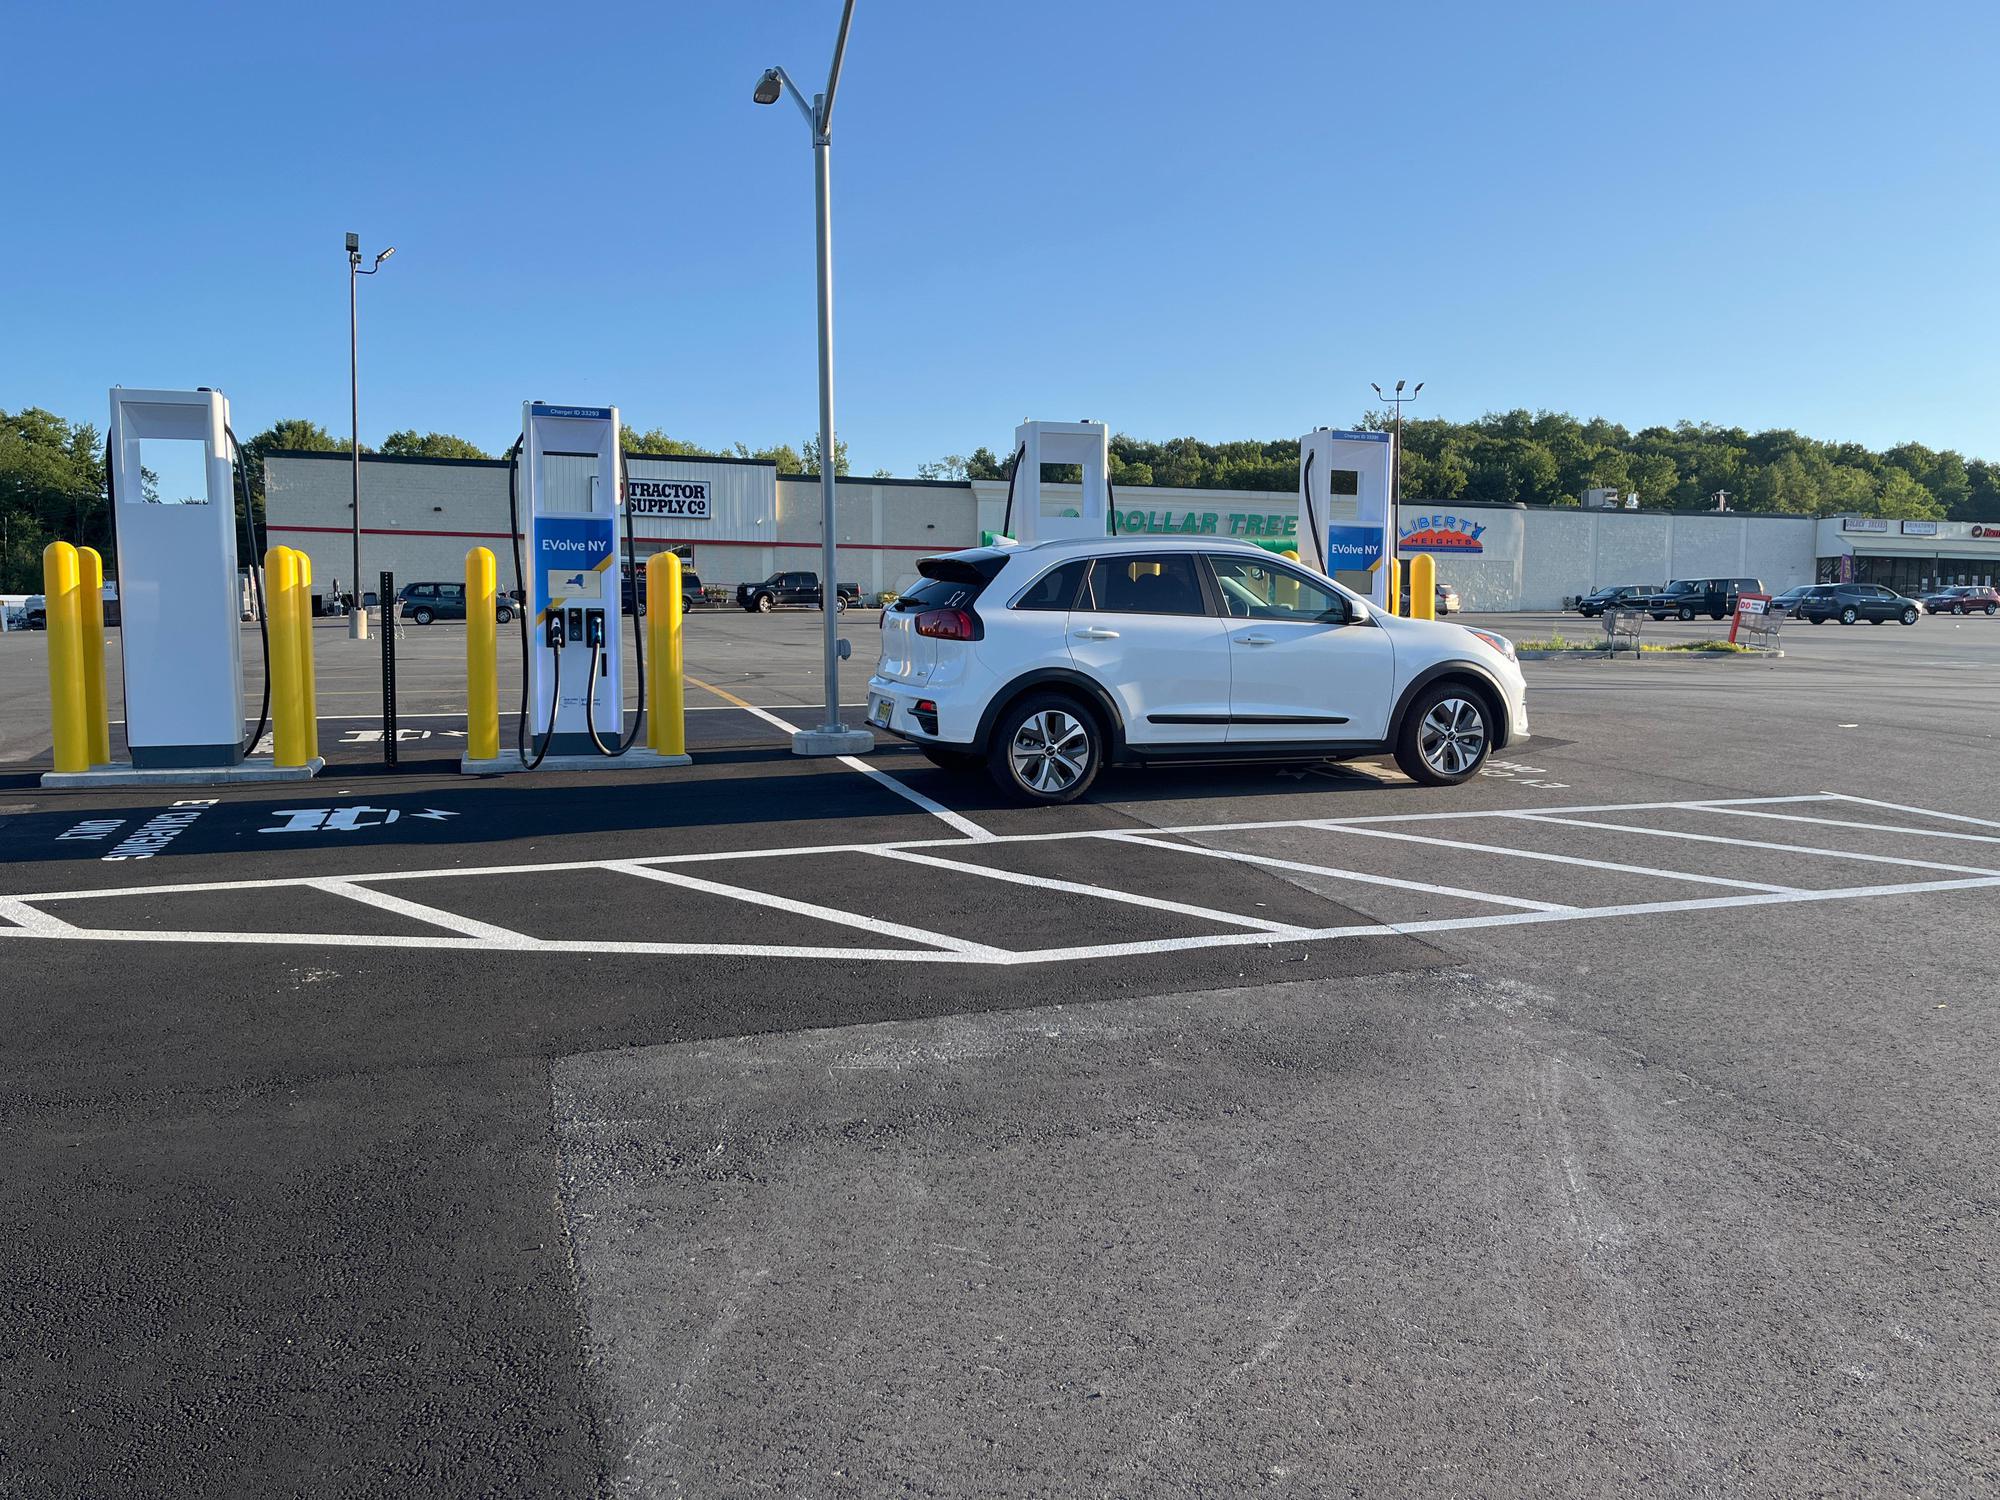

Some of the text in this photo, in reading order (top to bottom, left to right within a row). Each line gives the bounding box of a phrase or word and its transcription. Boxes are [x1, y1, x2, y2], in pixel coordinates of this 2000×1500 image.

[550, 408, 573, 416] Charger
[630, 483, 706, 499] TRACTOR
[631, 498, 686, 514] SUPPLY
[1106, 509, 1298, 537] DOLLAR TREE
[1399, 515, 1487, 540] LIBERTY
[542, 539, 608, 552] EVolve NY
[1331, 544, 1379, 555] EVolve NY
[54, 819, 127, 841] ONLY
[101, 812, 202, 861] CHARGING
